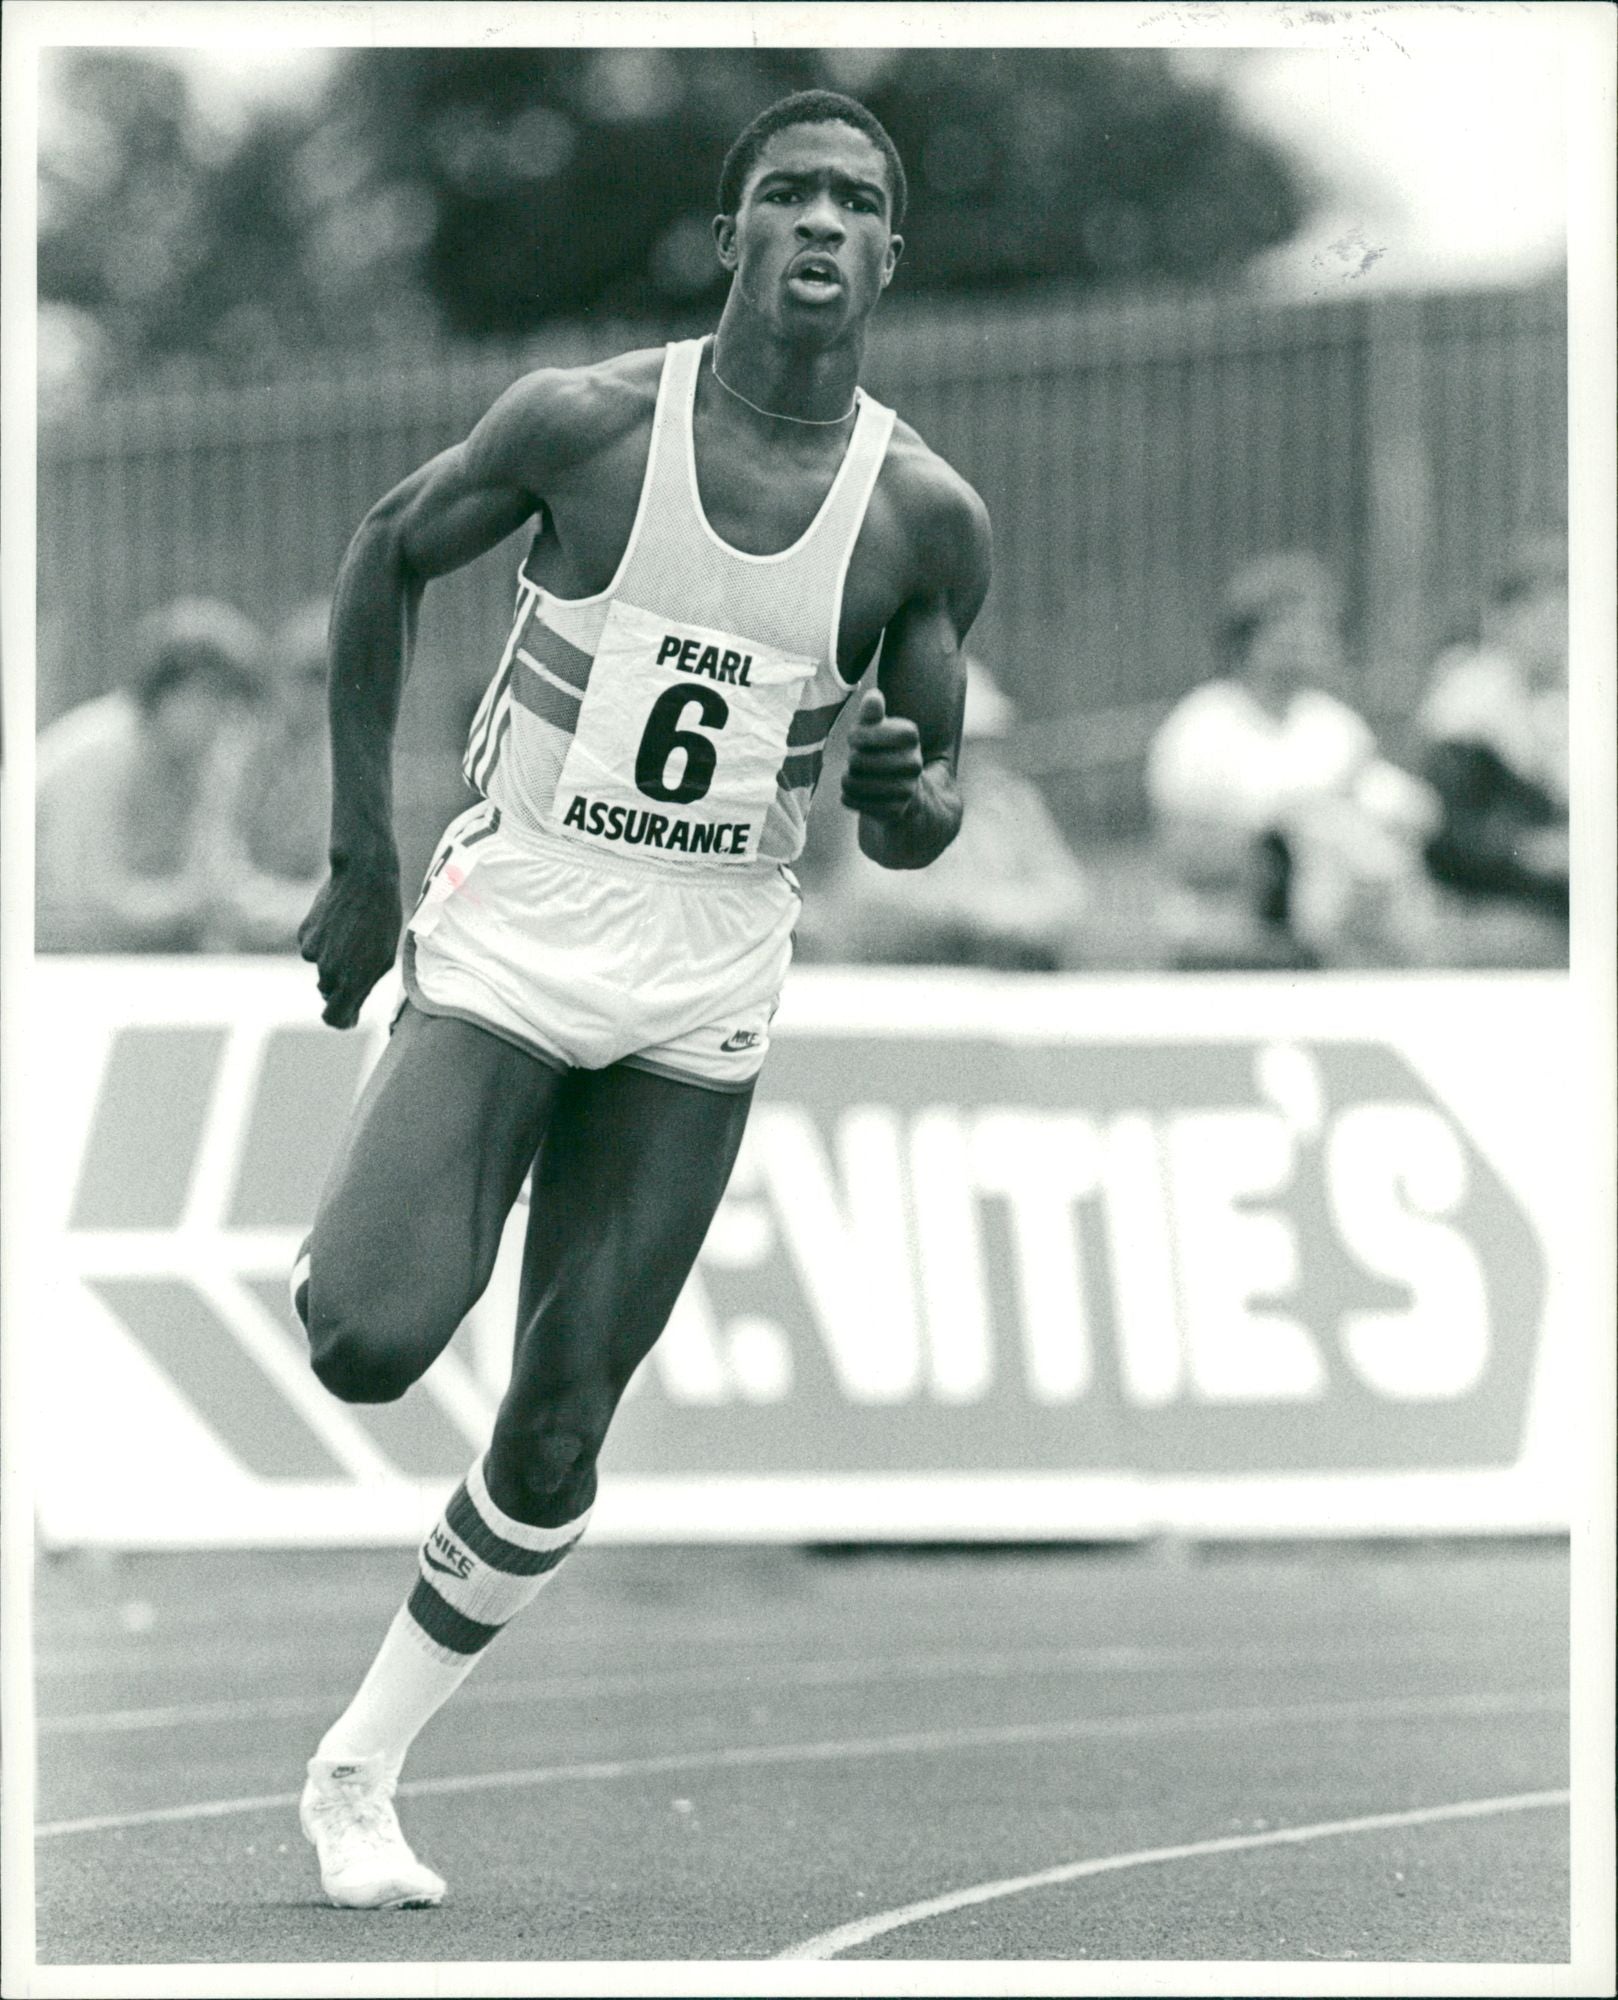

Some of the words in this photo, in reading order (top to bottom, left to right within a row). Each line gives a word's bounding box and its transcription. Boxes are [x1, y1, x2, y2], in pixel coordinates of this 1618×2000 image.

[655, 635, 752, 687] PEARL
[635, 682, 730, 805] 6
[563, 795, 751, 855] ASSURANCE
[731, 1030, 759, 1047] NIKE
[430, 1523, 475, 1579] NIKE
